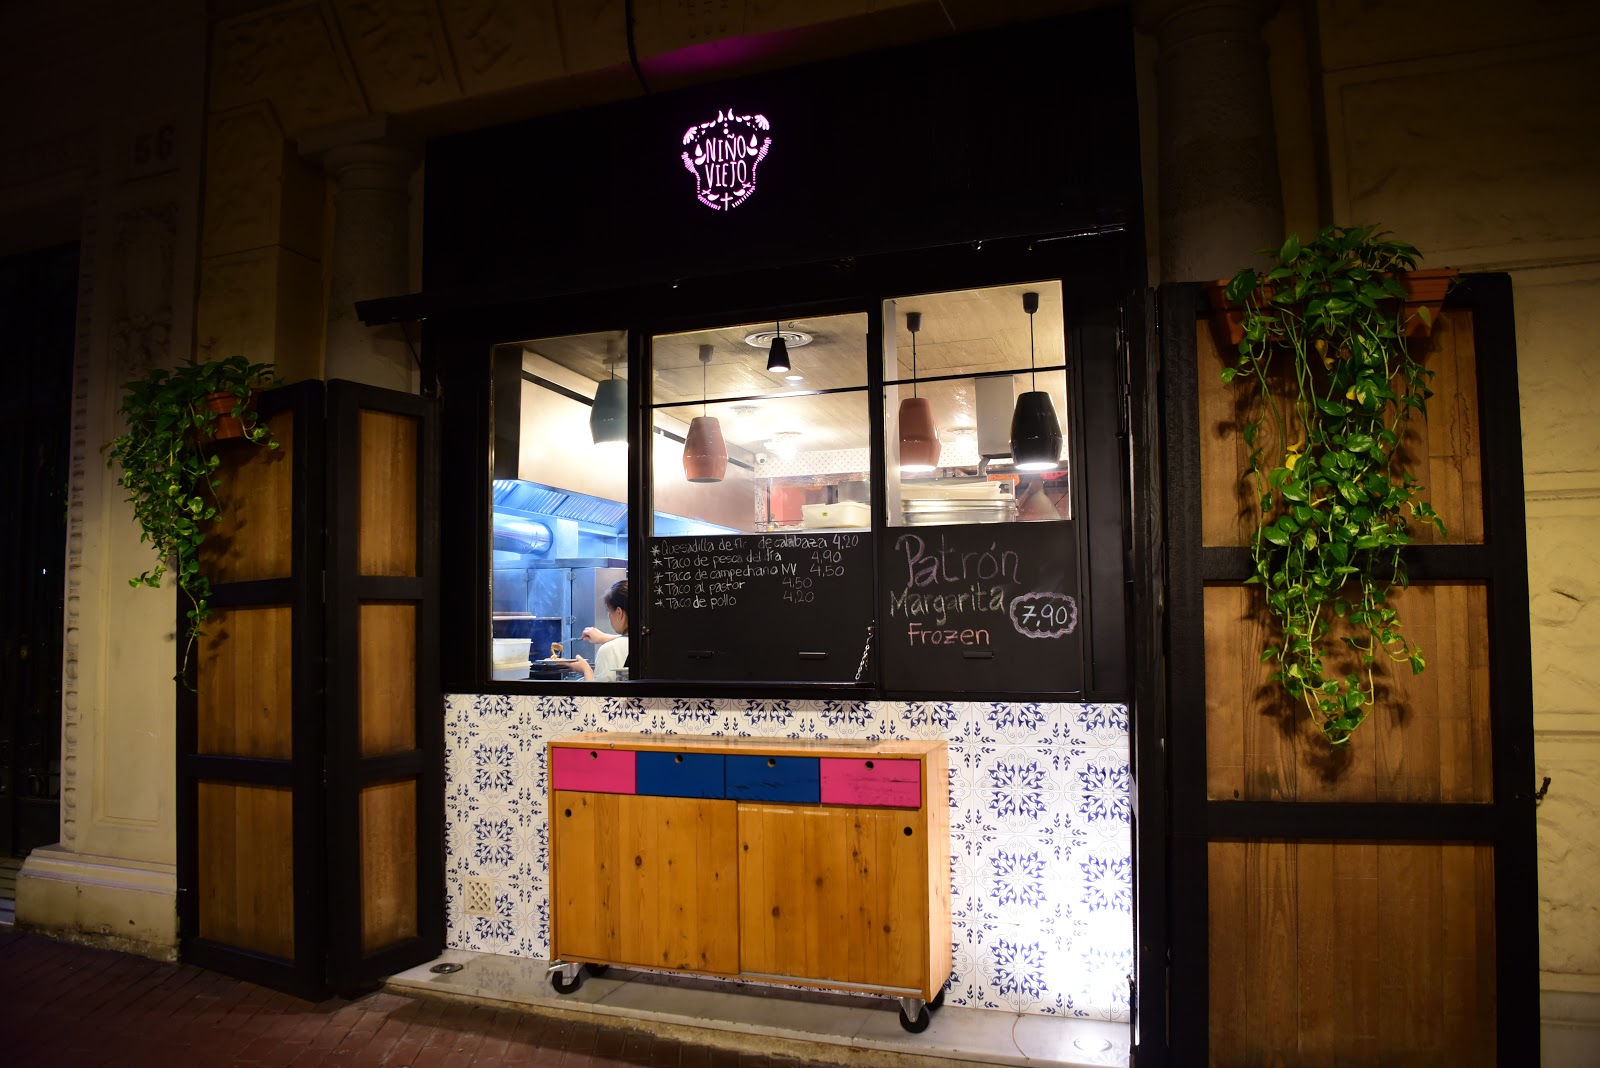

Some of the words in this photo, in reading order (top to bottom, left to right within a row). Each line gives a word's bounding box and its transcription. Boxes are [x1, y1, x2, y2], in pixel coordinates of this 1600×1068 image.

[705, 133, 747, 163] NIÑO
[704, 160, 747, 189] VIEJO
[661, 538, 714, 556] Quesadilla
[718, 537, 734, 551] de
[758, 535, 772, 549] de
[774, 535, 828, 549] calabaza
[663, 556, 691, 570] Taco
[693, 554, 710, 567] de
[712, 554, 744, 569] pesca
[746, 549, 761, 563] del
[894, 533, 1022, 588] Patrón
[664, 571, 692, 582] Taco
[694, 569, 708, 581] de
[709, 564, 779, 582] campechano
[664, 583, 691, 596] Taco
[694, 581, 705, 594] al
[708, 578, 745, 596] pastor
[665, 597, 691, 610] Taco
[692, 595, 708, 609] de
[710, 594, 737, 610] pollo
[889, 581, 1006, 626] Margarita
[1021, 603, 1068, 628] 7,90
[907, 622, 990, 647] Frozen
